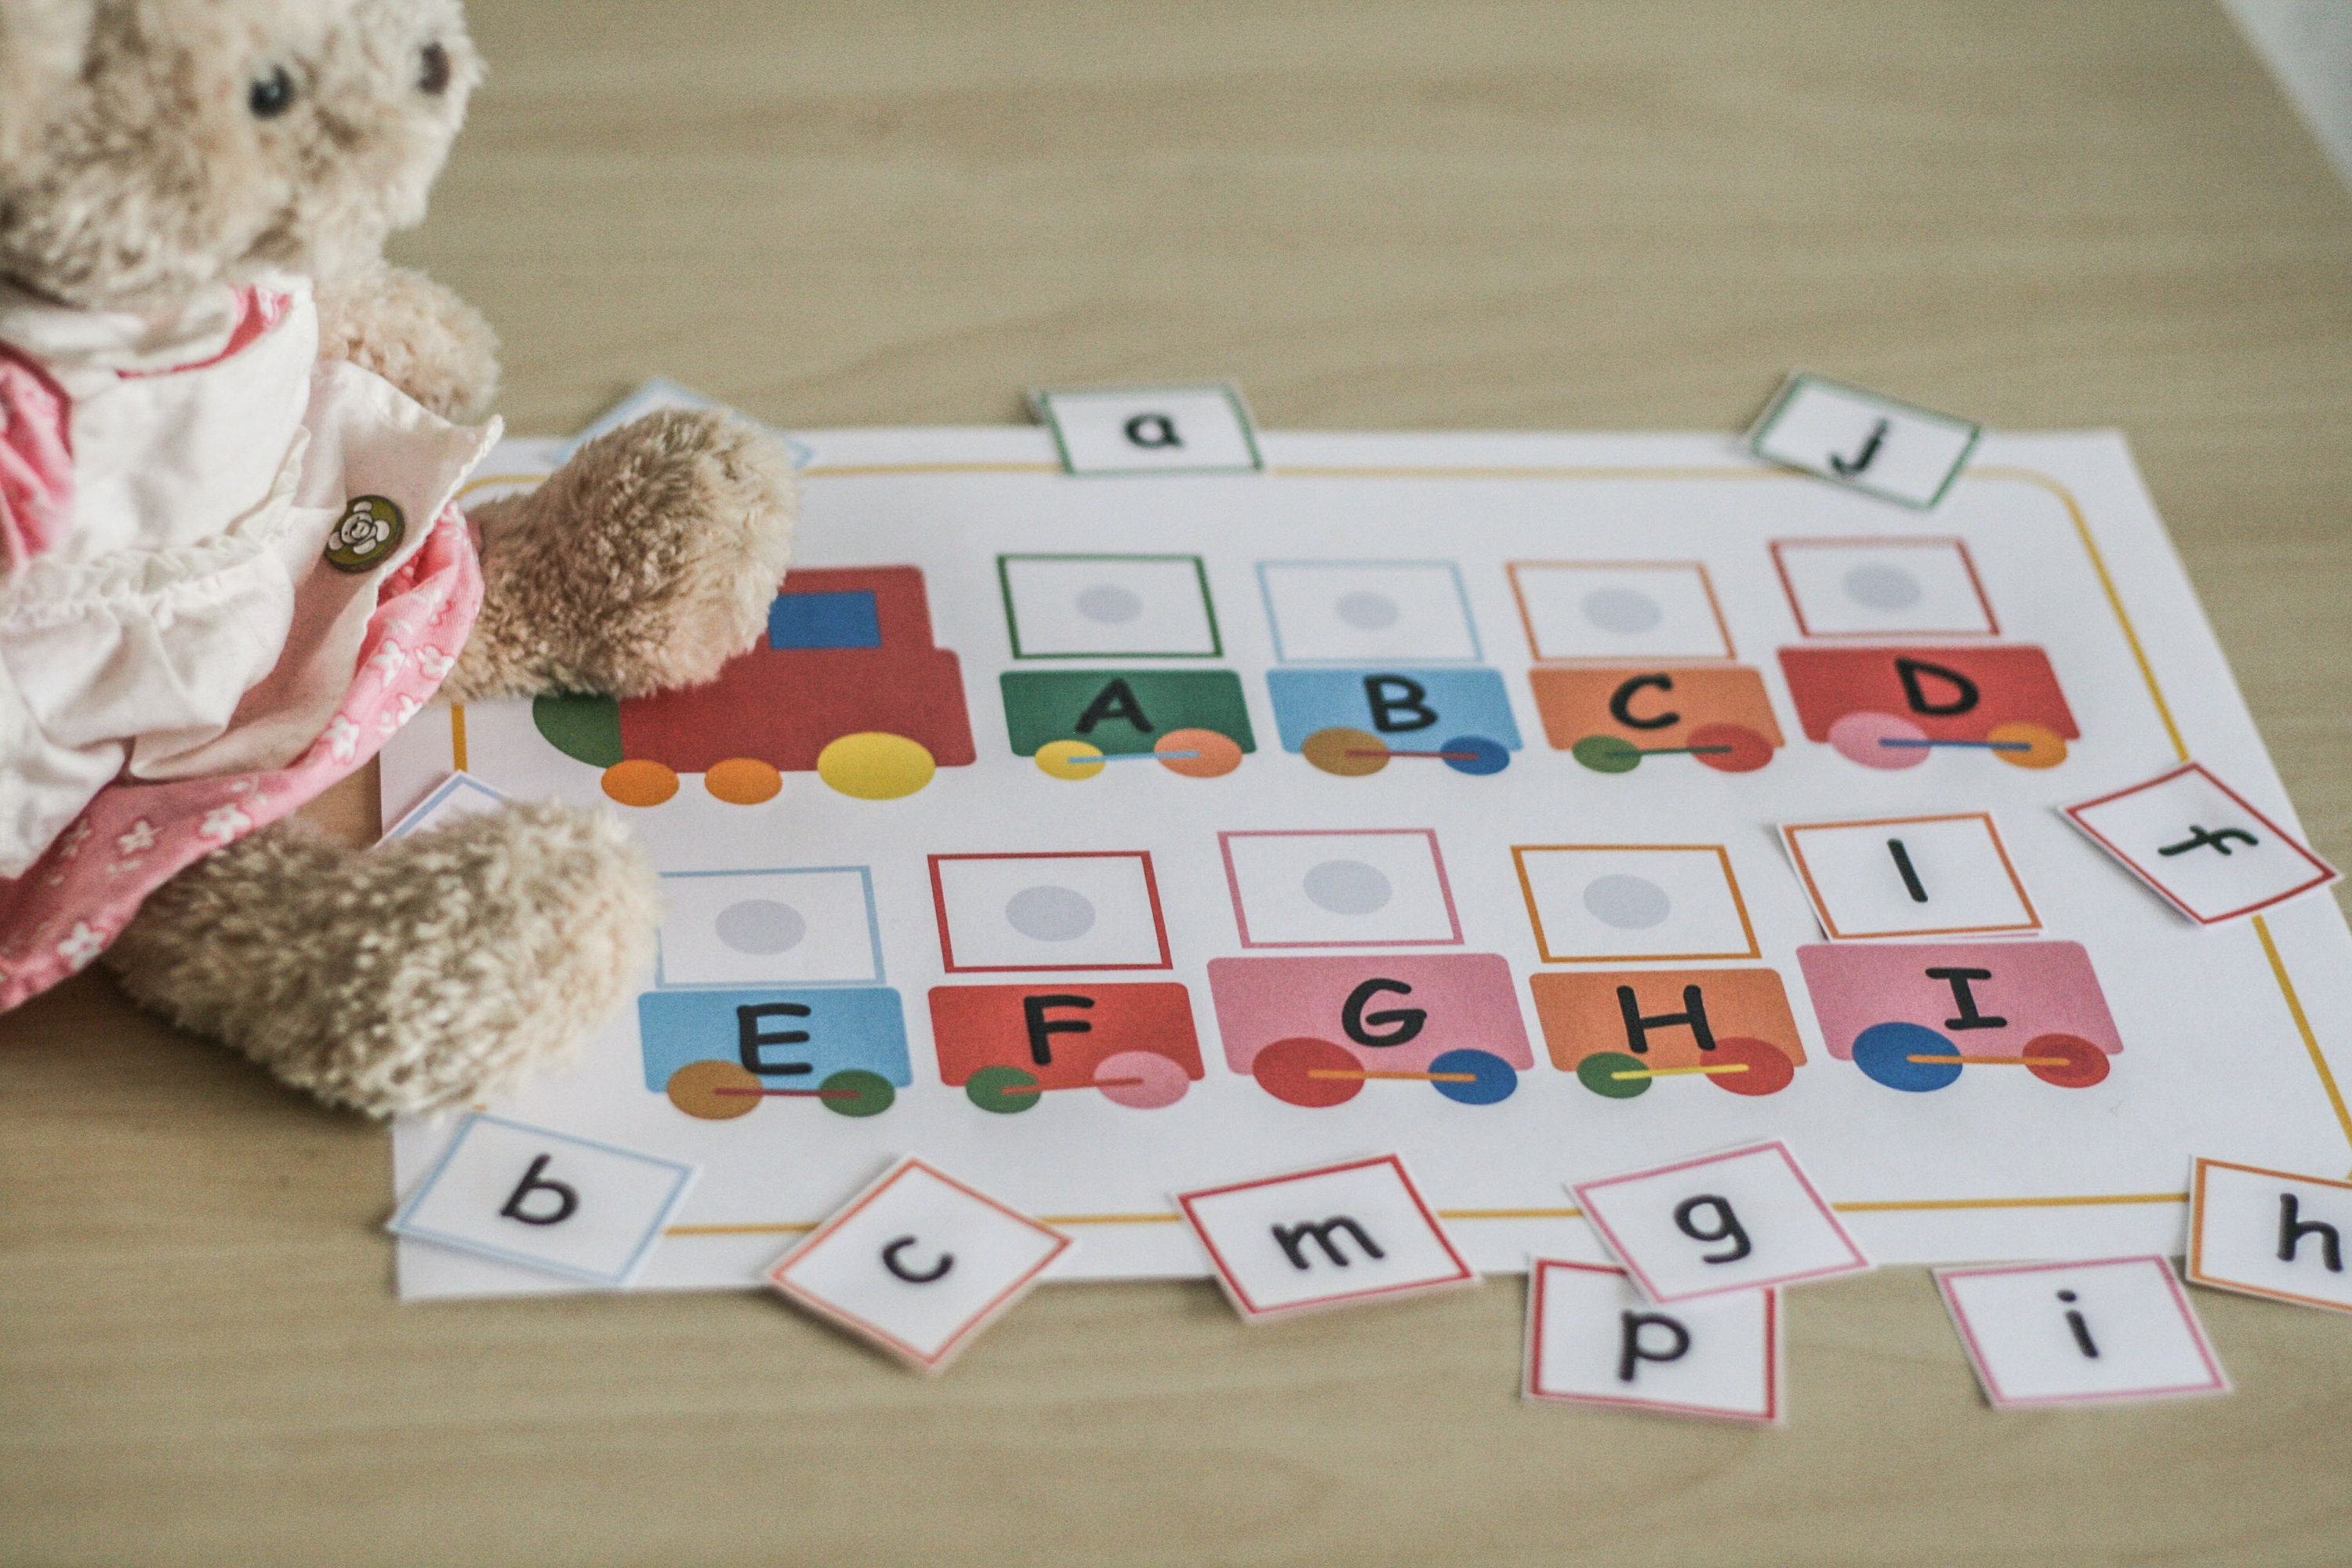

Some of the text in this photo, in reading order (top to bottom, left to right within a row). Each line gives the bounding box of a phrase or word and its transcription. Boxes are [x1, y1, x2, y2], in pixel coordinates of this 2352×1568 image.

[1123, 414, 1181, 448] a
[1076, 659, 1979, 734] A B C D
[2158, 826, 2258, 856] f
[737, 968, 2007, 1076] E F G H I
[500, 1156, 578, 1225] b
[882, 1237, 953, 1283] c
[1272, 1218, 1384, 1269] m
[1675, 1196, 1751, 1264] g
[2278, 1194, 2342, 1272] h
[2058, 1291, 2098, 1358] i
